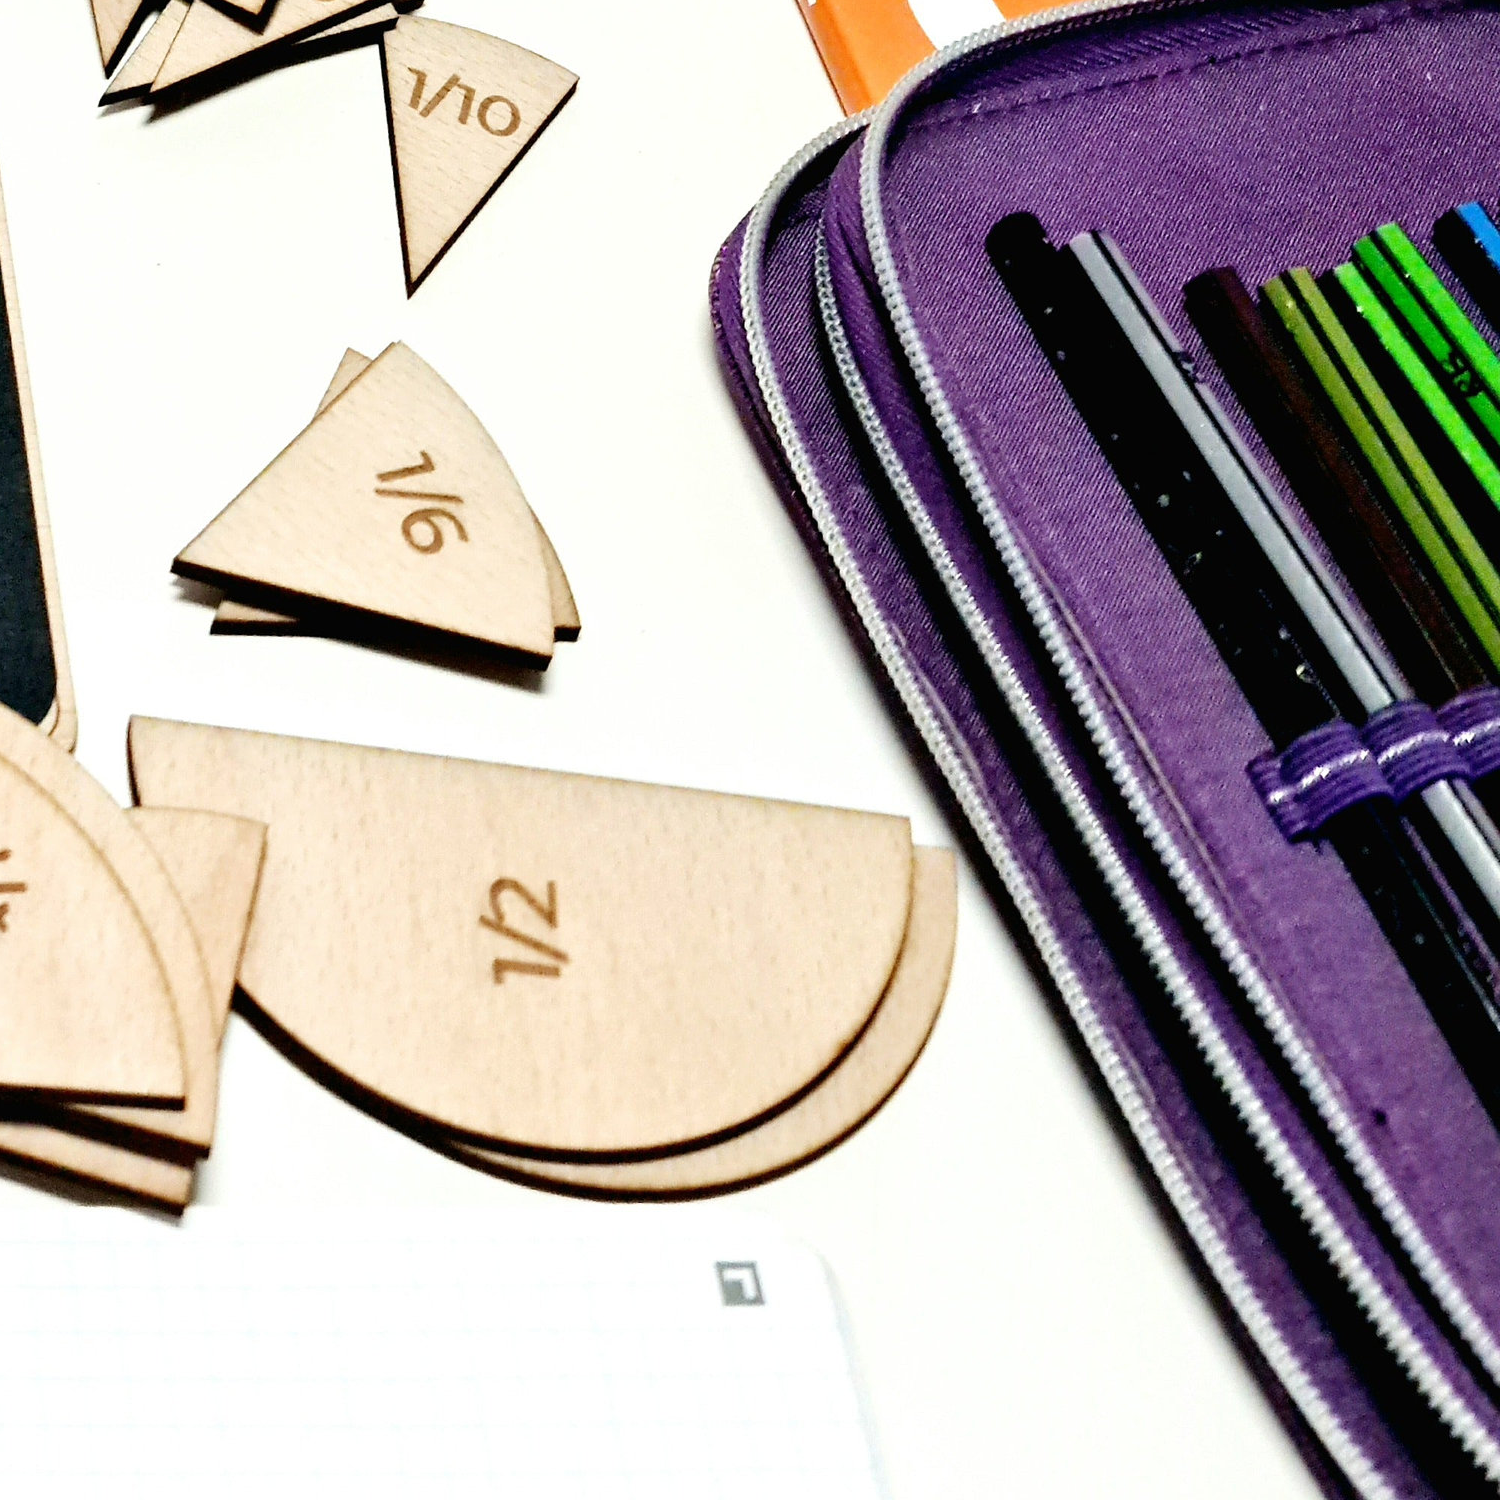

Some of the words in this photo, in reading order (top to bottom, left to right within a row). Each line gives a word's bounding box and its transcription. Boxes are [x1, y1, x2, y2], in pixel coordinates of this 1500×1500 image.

[407, 66, 522, 138] 1/10
[374, 450, 469, 555] 1/6
[478, 877, 569, 985] 1/2
